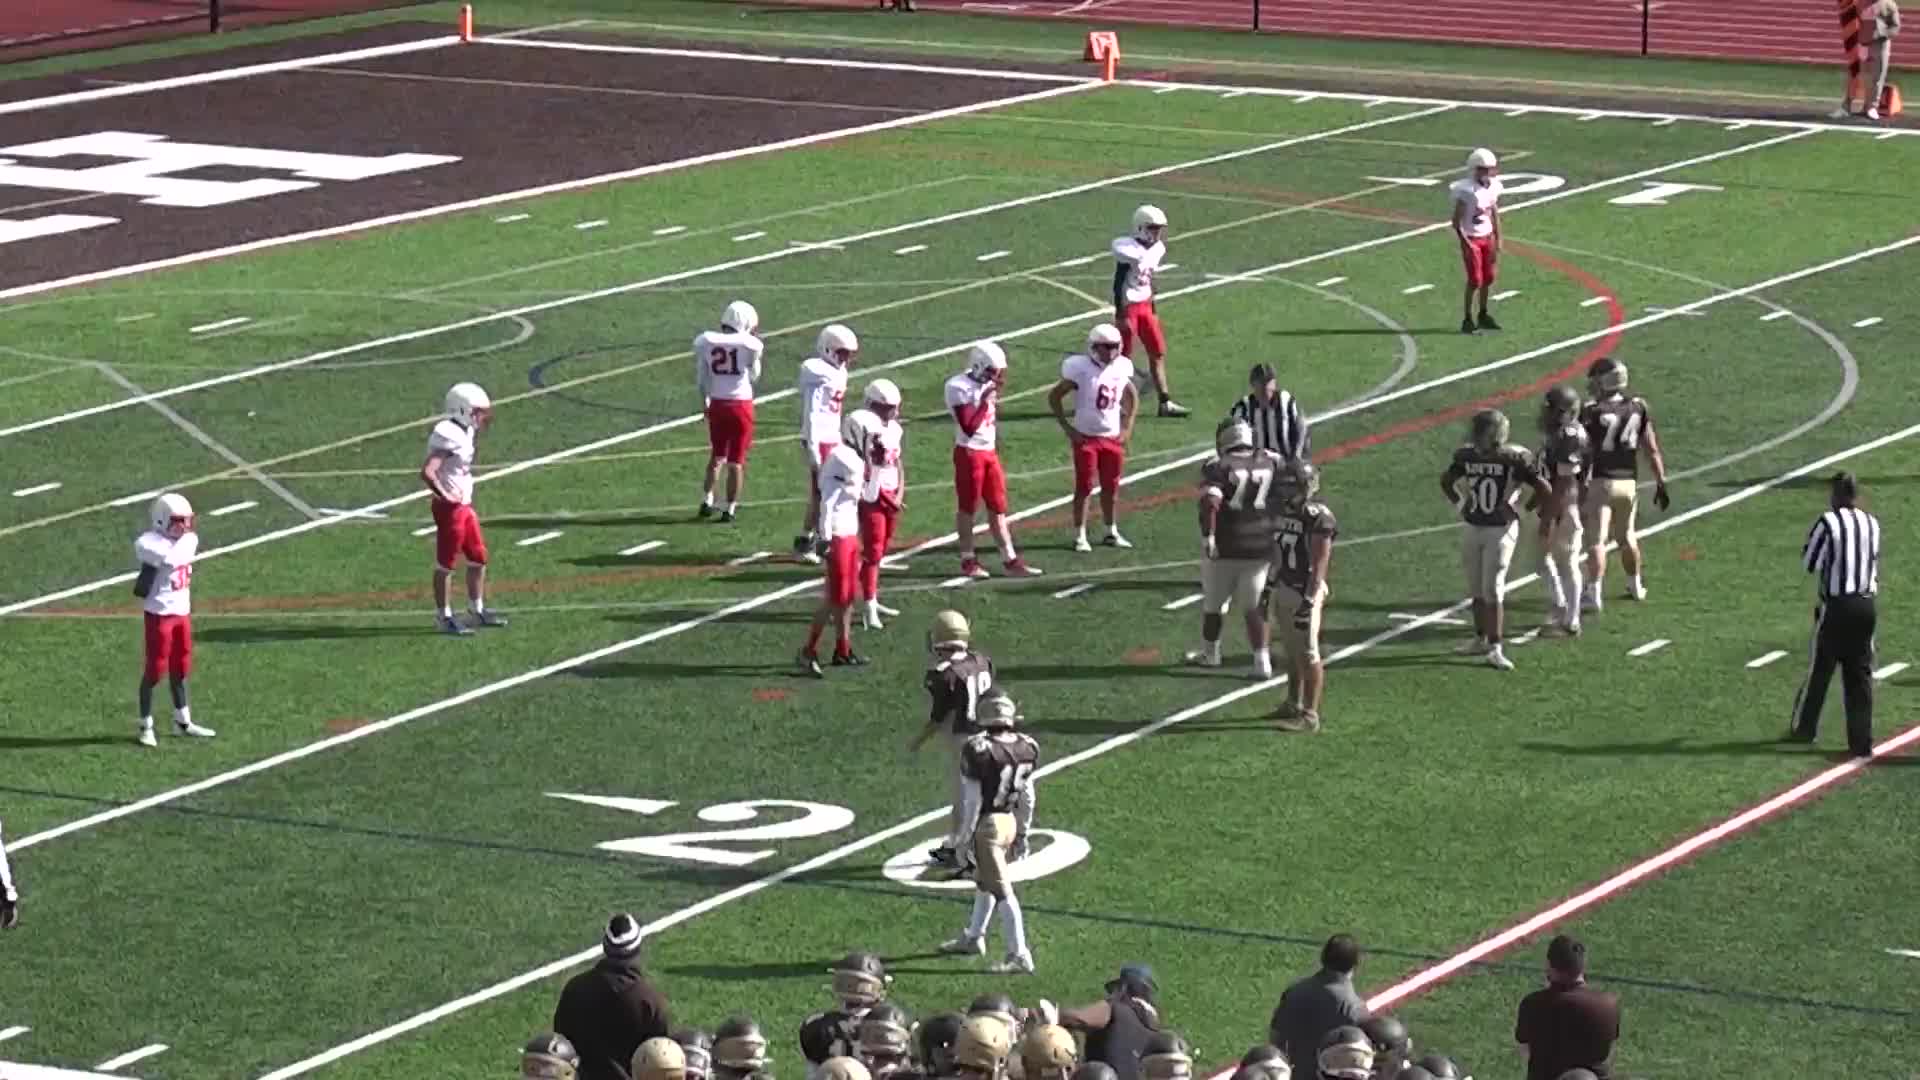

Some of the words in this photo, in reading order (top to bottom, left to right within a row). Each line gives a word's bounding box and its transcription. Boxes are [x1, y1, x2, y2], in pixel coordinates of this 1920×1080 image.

[710, 346, 739, 376] 21
[1095, 384, 1116, 410] 61
[1599, 412, 1640, 451] 74
[1228, 468, 1273, 510] 77
